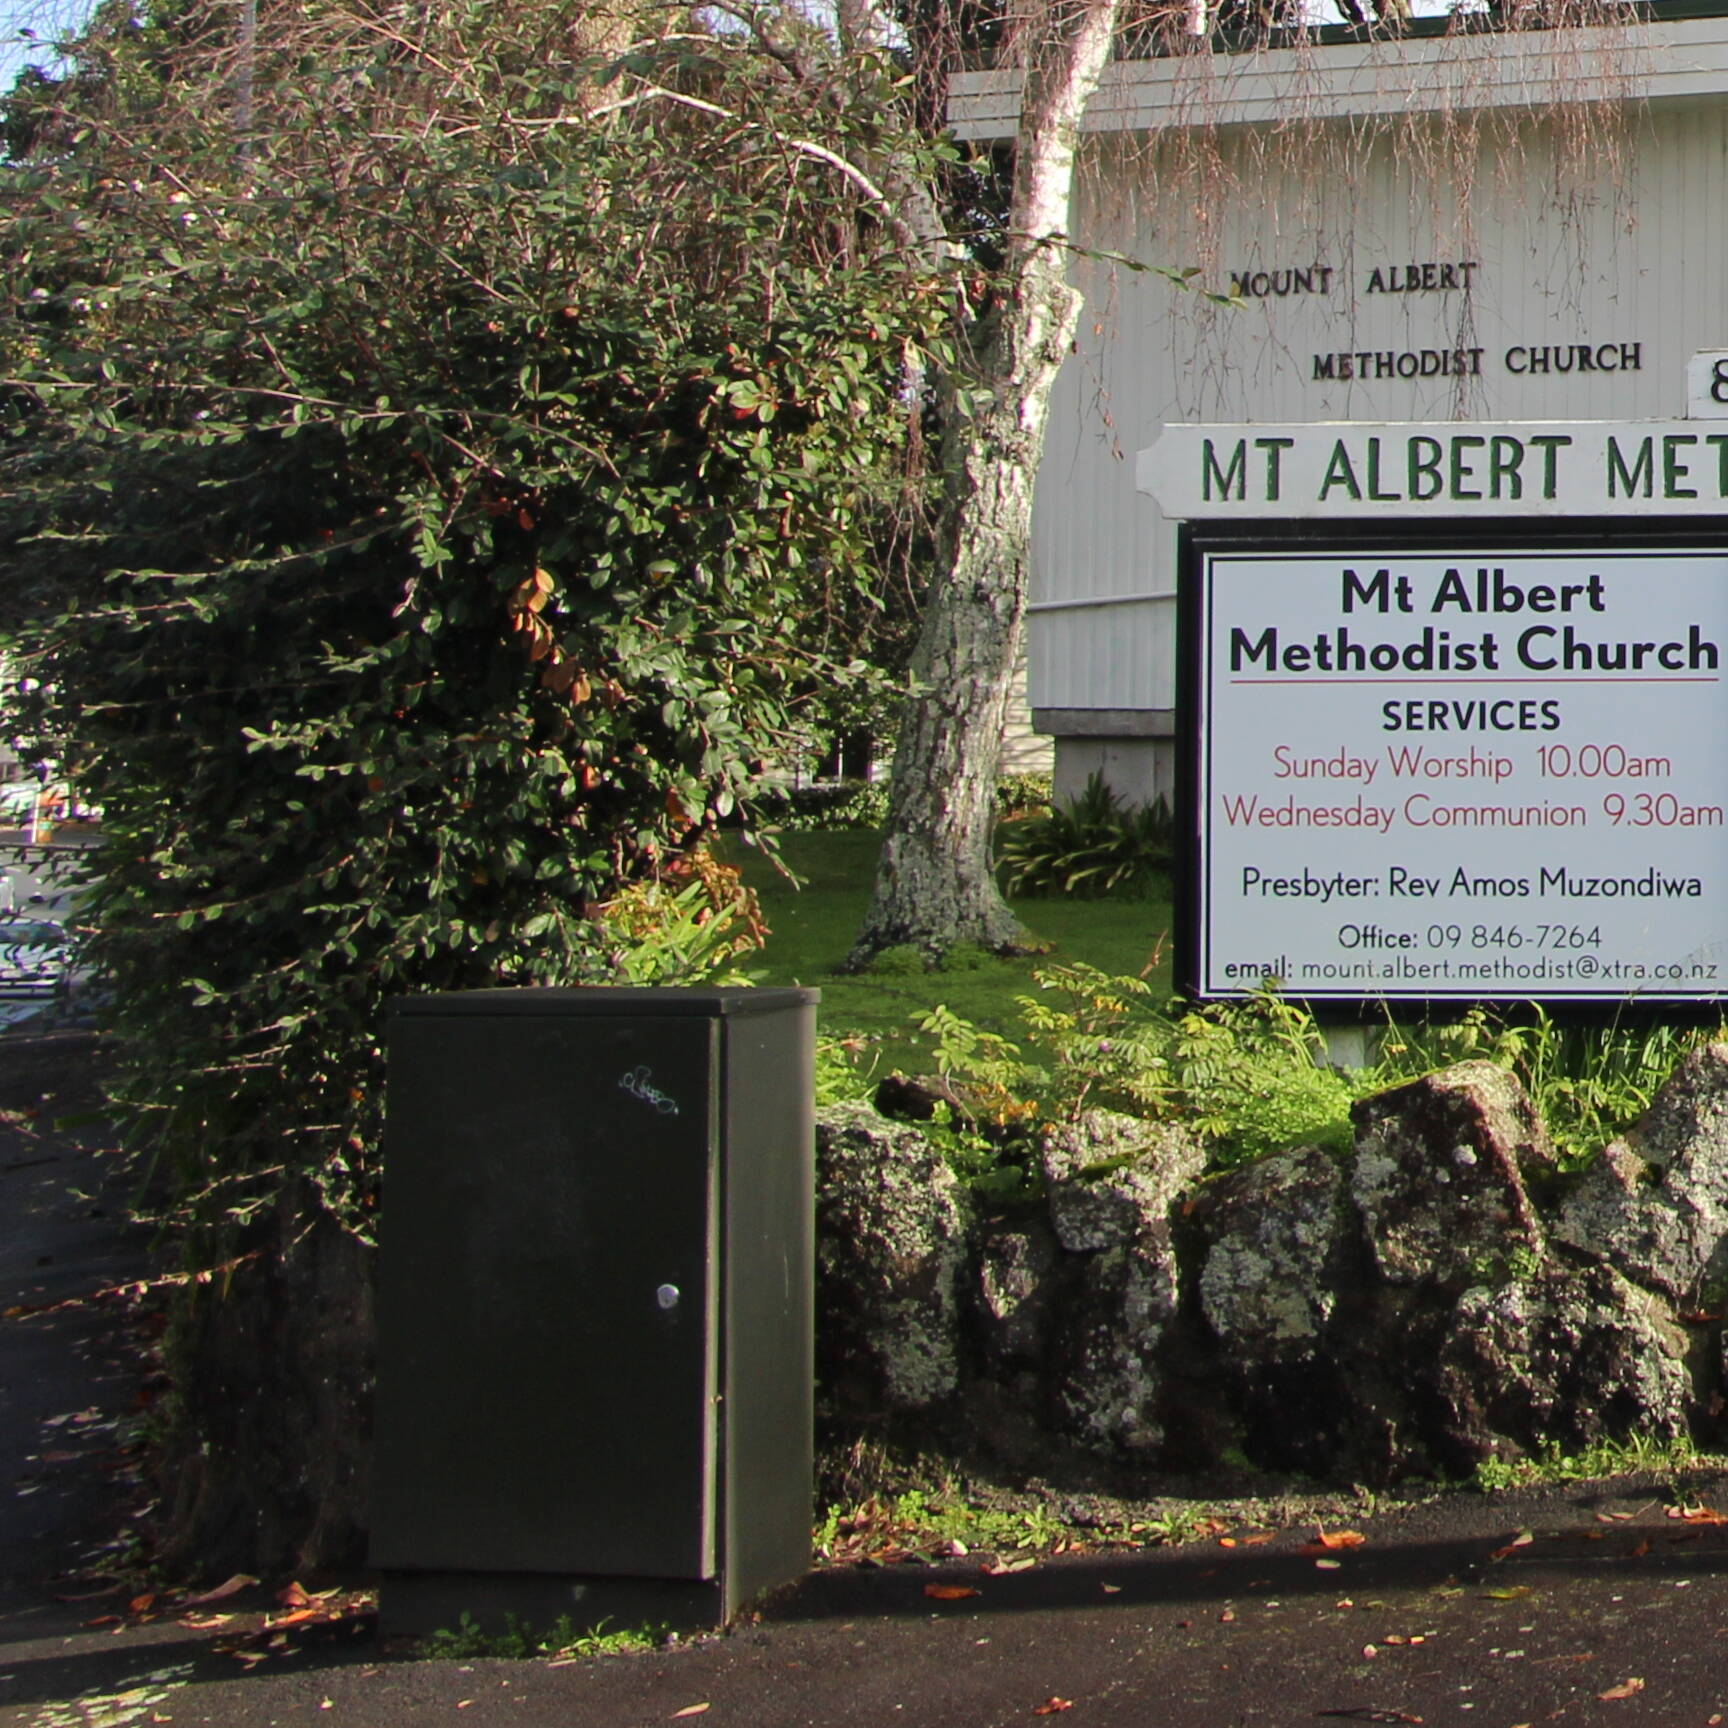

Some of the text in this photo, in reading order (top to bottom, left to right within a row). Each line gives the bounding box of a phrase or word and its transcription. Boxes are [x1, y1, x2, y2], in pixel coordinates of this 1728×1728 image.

[1231, 262, 1478, 298] MOUNT ALBERT
[1312, 342, 1642, 381] METHODIST CHURCH
[1202, 437, 1295, 502] MT
[1317, 435, 1573, 502] ALBERT
[1341, 567, 1607, 614] Mt Albert
[1229, 624, 1720, 673] Methodist Church
[1381, 699, 1562, 732] SERVICES
[1272, 744, 1672, 785] Sunday Worship 10.00am
[1222, 792, 1725, 834] Wednesday Communion 9.30am
[1241, 866, 1703, 903] Presbyter: Rev Amos Muzondiwa
[1338, 924, 1603, 949] Office: 09 846-7264
[1225, 954, 1719, 980] email: mount.albert.methodist@xtra.co.nz
